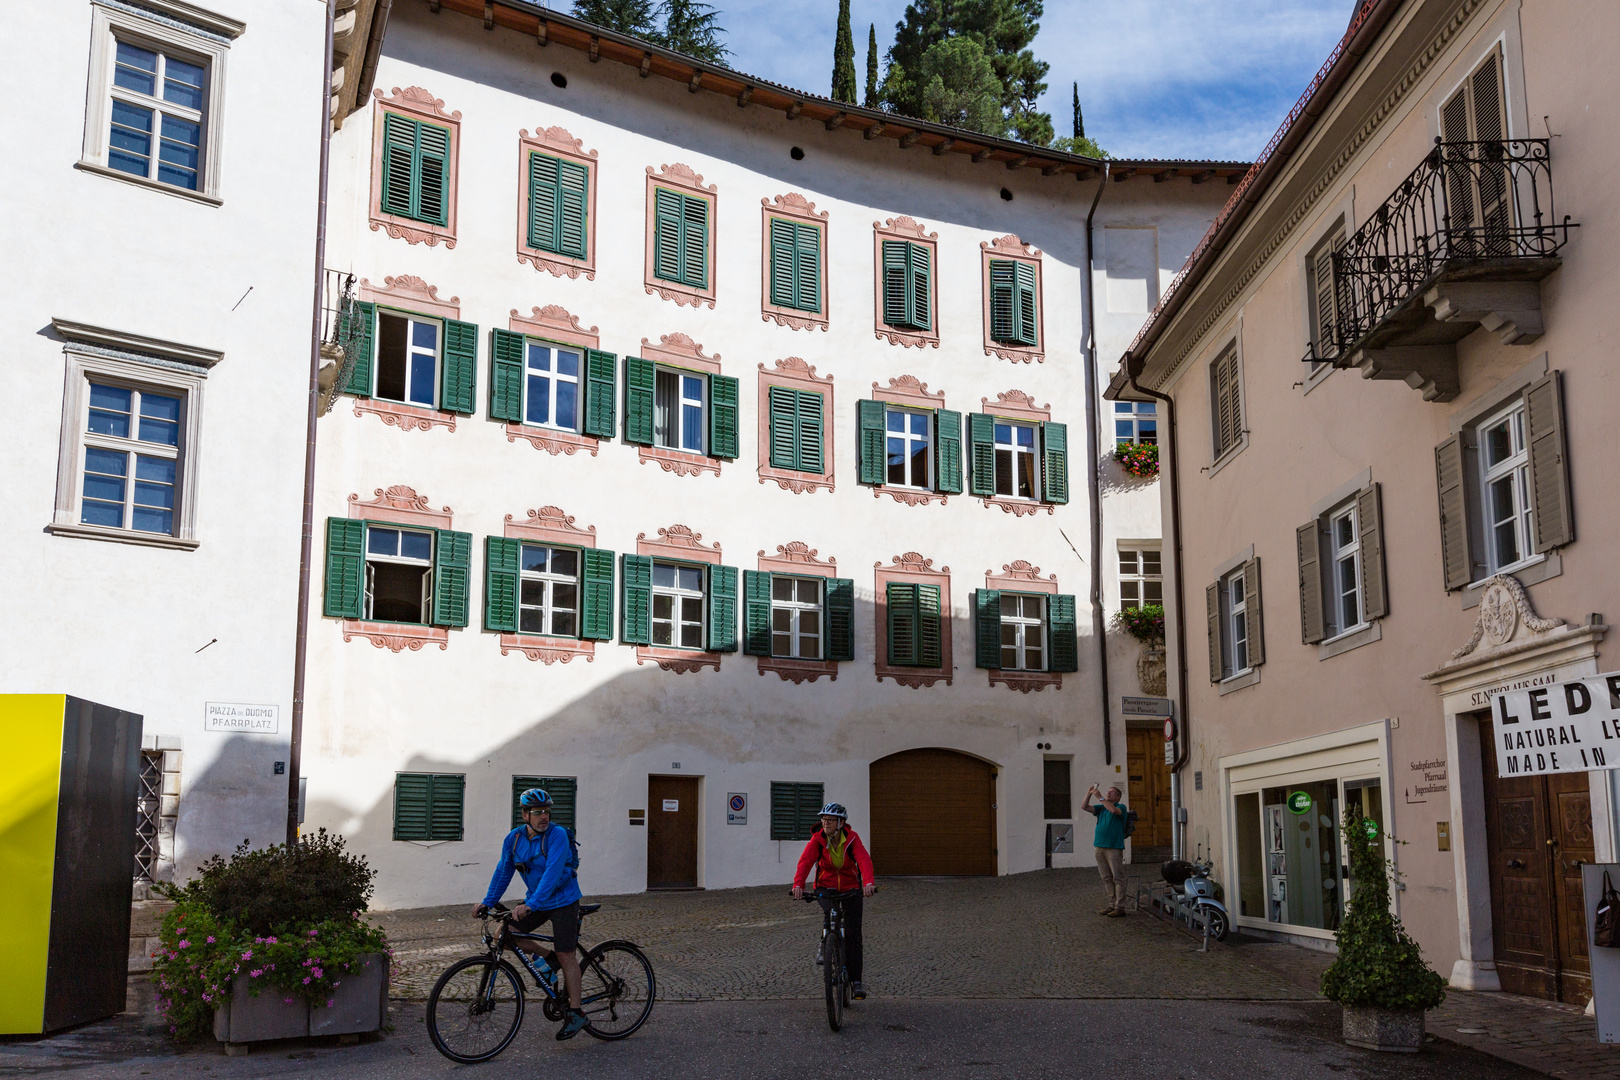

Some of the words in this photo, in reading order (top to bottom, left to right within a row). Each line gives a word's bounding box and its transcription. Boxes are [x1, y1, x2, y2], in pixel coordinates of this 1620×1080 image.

[209, 706, 236, 715] PIAZZA
[245, 708, 273, 717] DUOMO
[212, 718, 271, 728] PFARRPLATZ
[1504, 725, 1581, 750] NATURAL
[1410, 759, 1446, 772] Stadtpfarrchor
[1507, 752, 1559, 773] MADE
[1580, 747, 1606, 767] IN
[1424, 771, 1447, 782] Pfarrsaal
[1415, 784, 1447, 796] Jugendräume
